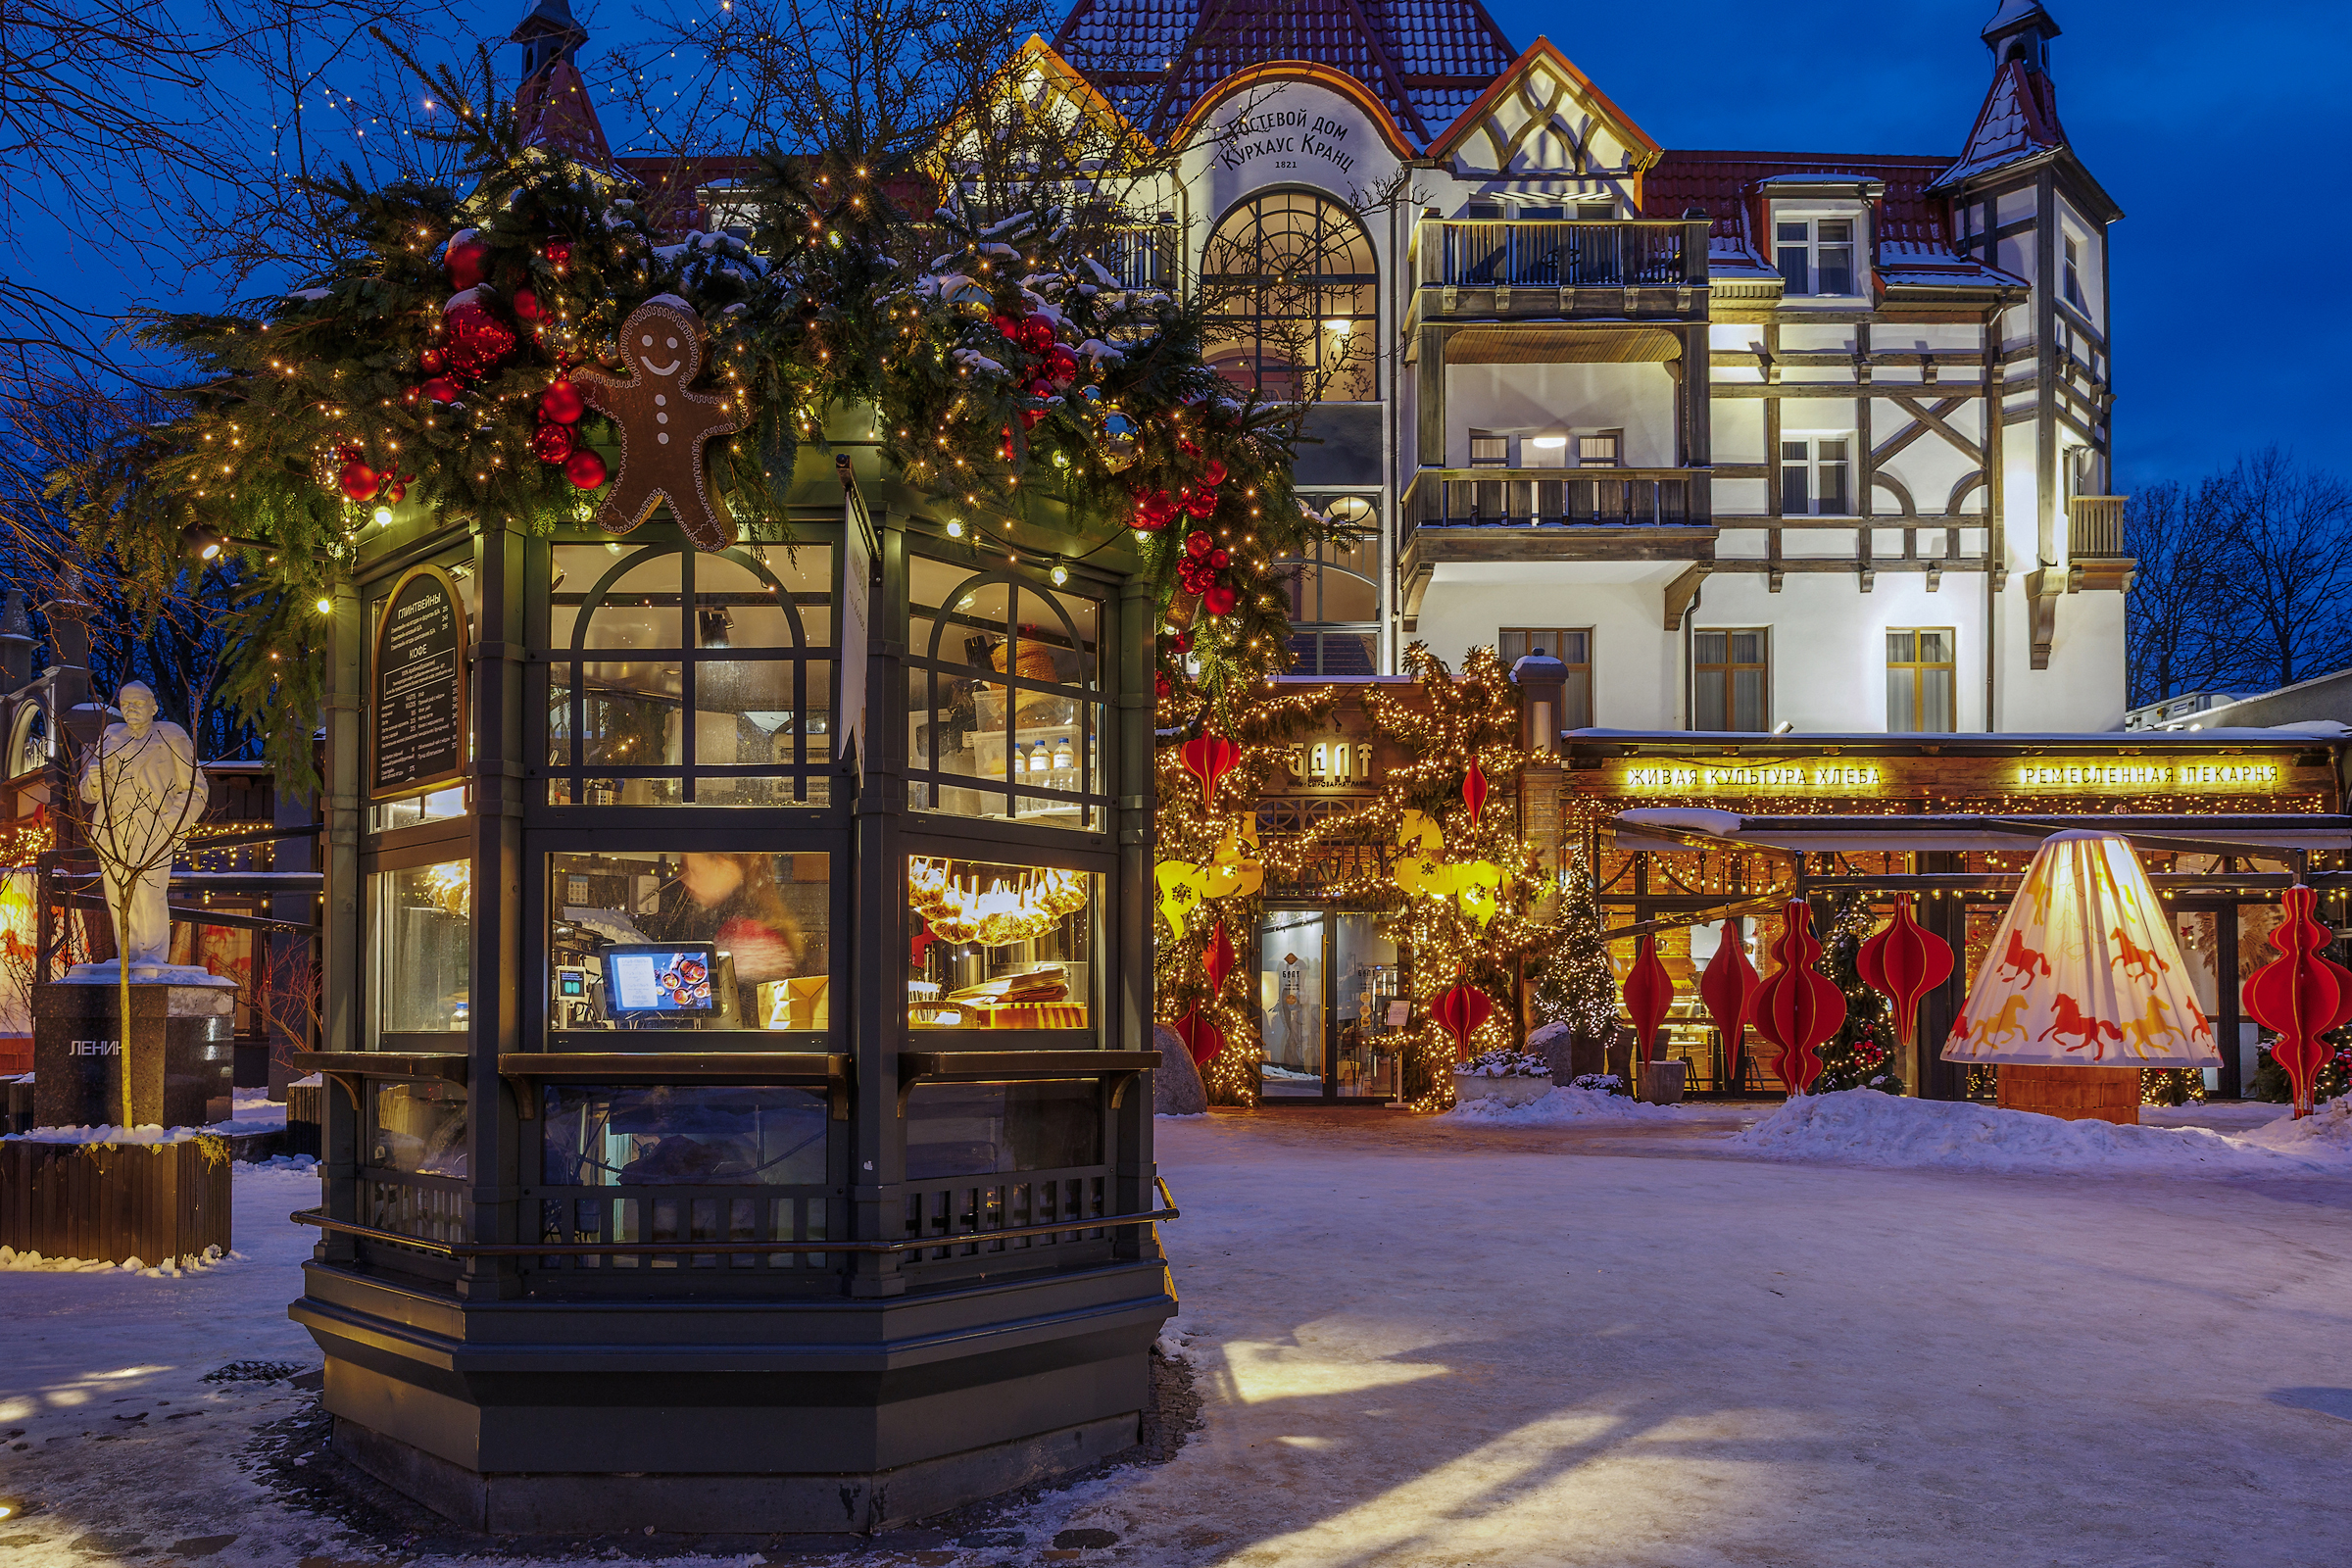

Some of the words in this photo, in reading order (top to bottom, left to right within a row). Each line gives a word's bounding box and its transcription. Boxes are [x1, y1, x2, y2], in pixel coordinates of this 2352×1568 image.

[1300, 132, 1354, 174] КРАНЦ
[398, 592, 441, 620] ГЛИНТВЕЙНЫ
[409, 643, 427, 661] КОФЕ
[1629, 768, 1698, 785] ЖИВАЯ
[1710, 768, 1808, 785] КУЛЬТУРА
[1819, 768, 1882, 785] ХЛЕБА
[2026, 766, 2175, 784] РЕМЕСЛЕННАЯ
[2185, 765, 2279, 783] ПЕКАРНЯ
